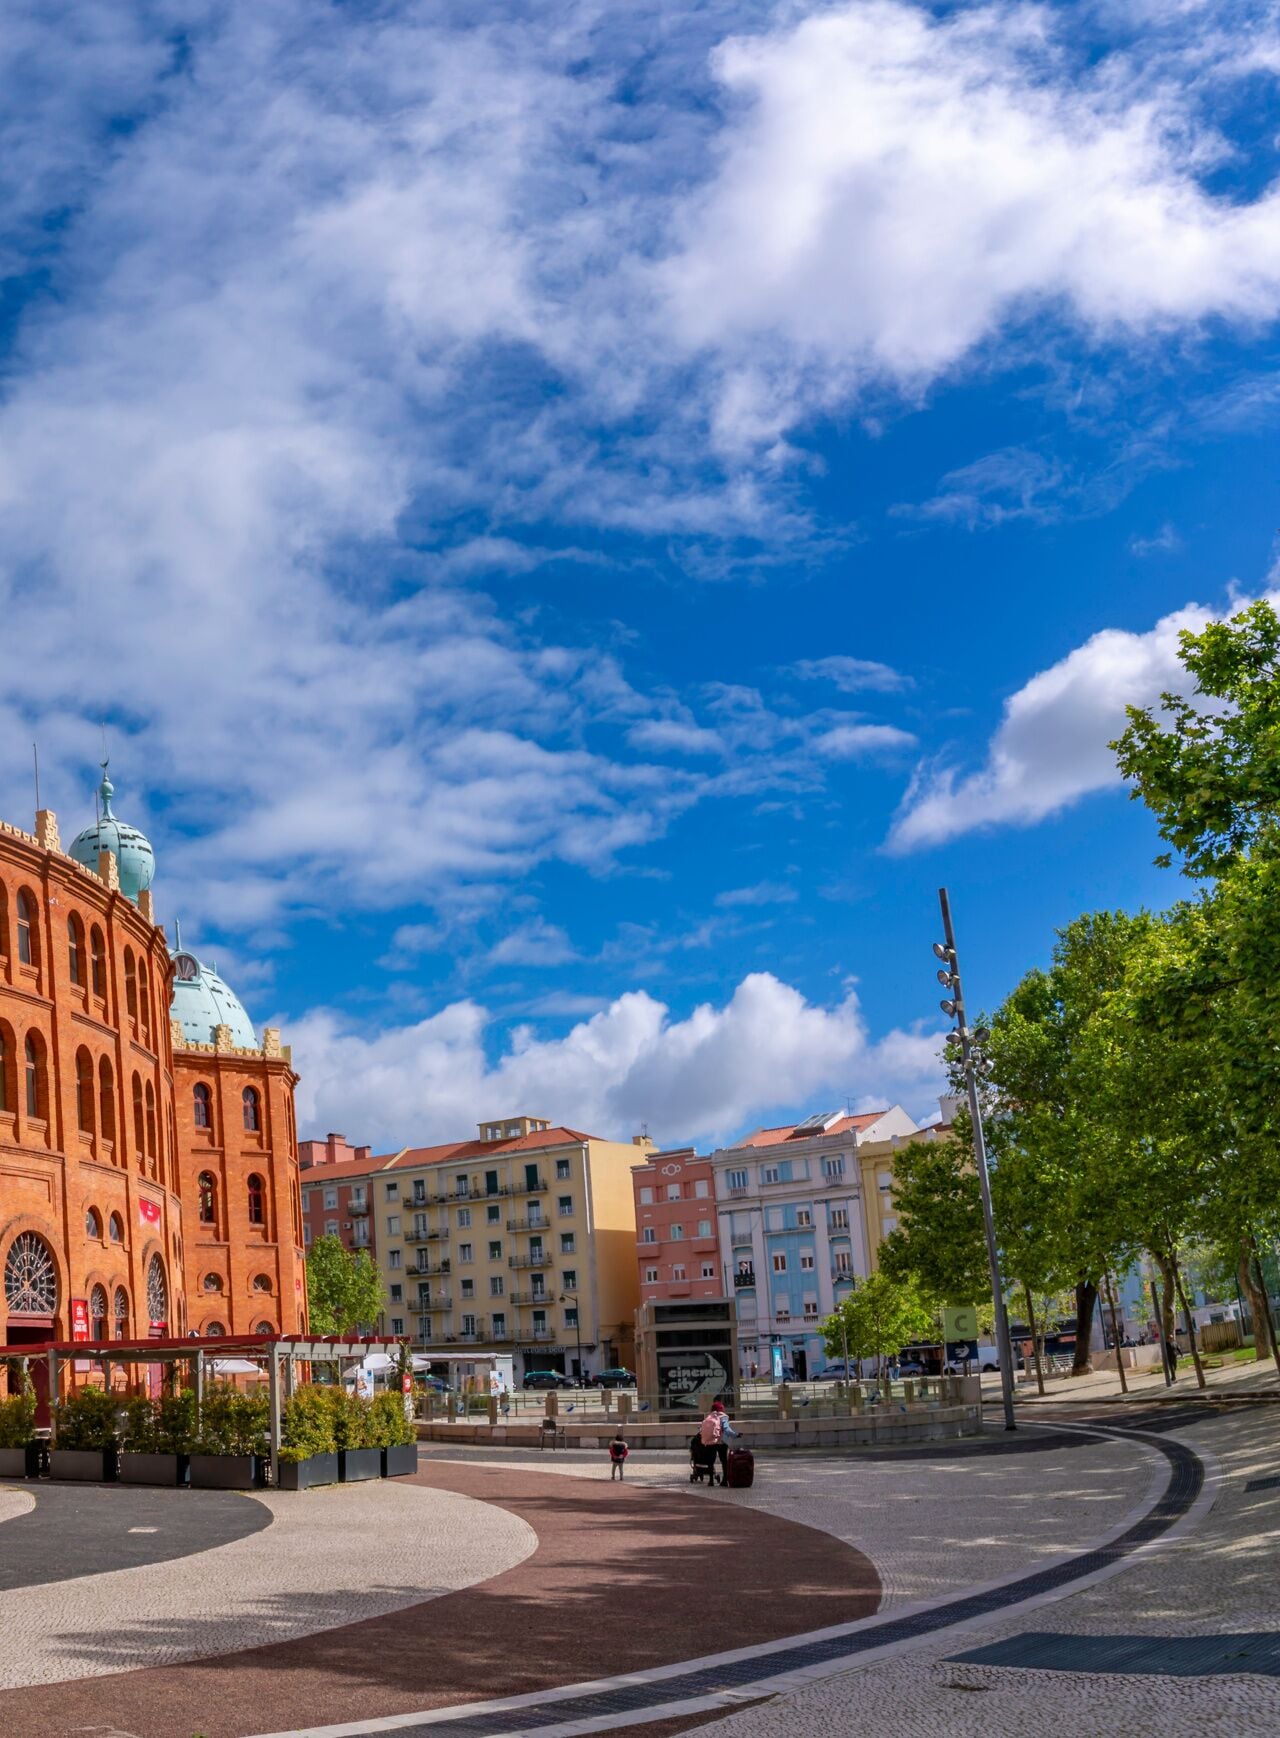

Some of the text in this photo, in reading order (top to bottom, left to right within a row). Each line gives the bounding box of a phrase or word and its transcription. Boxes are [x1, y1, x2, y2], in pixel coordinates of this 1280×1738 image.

[954, 1314, 968, 1332] C
[668, 1366, 723, 1378] cinema
[668, 1379, 698, 1391] city
